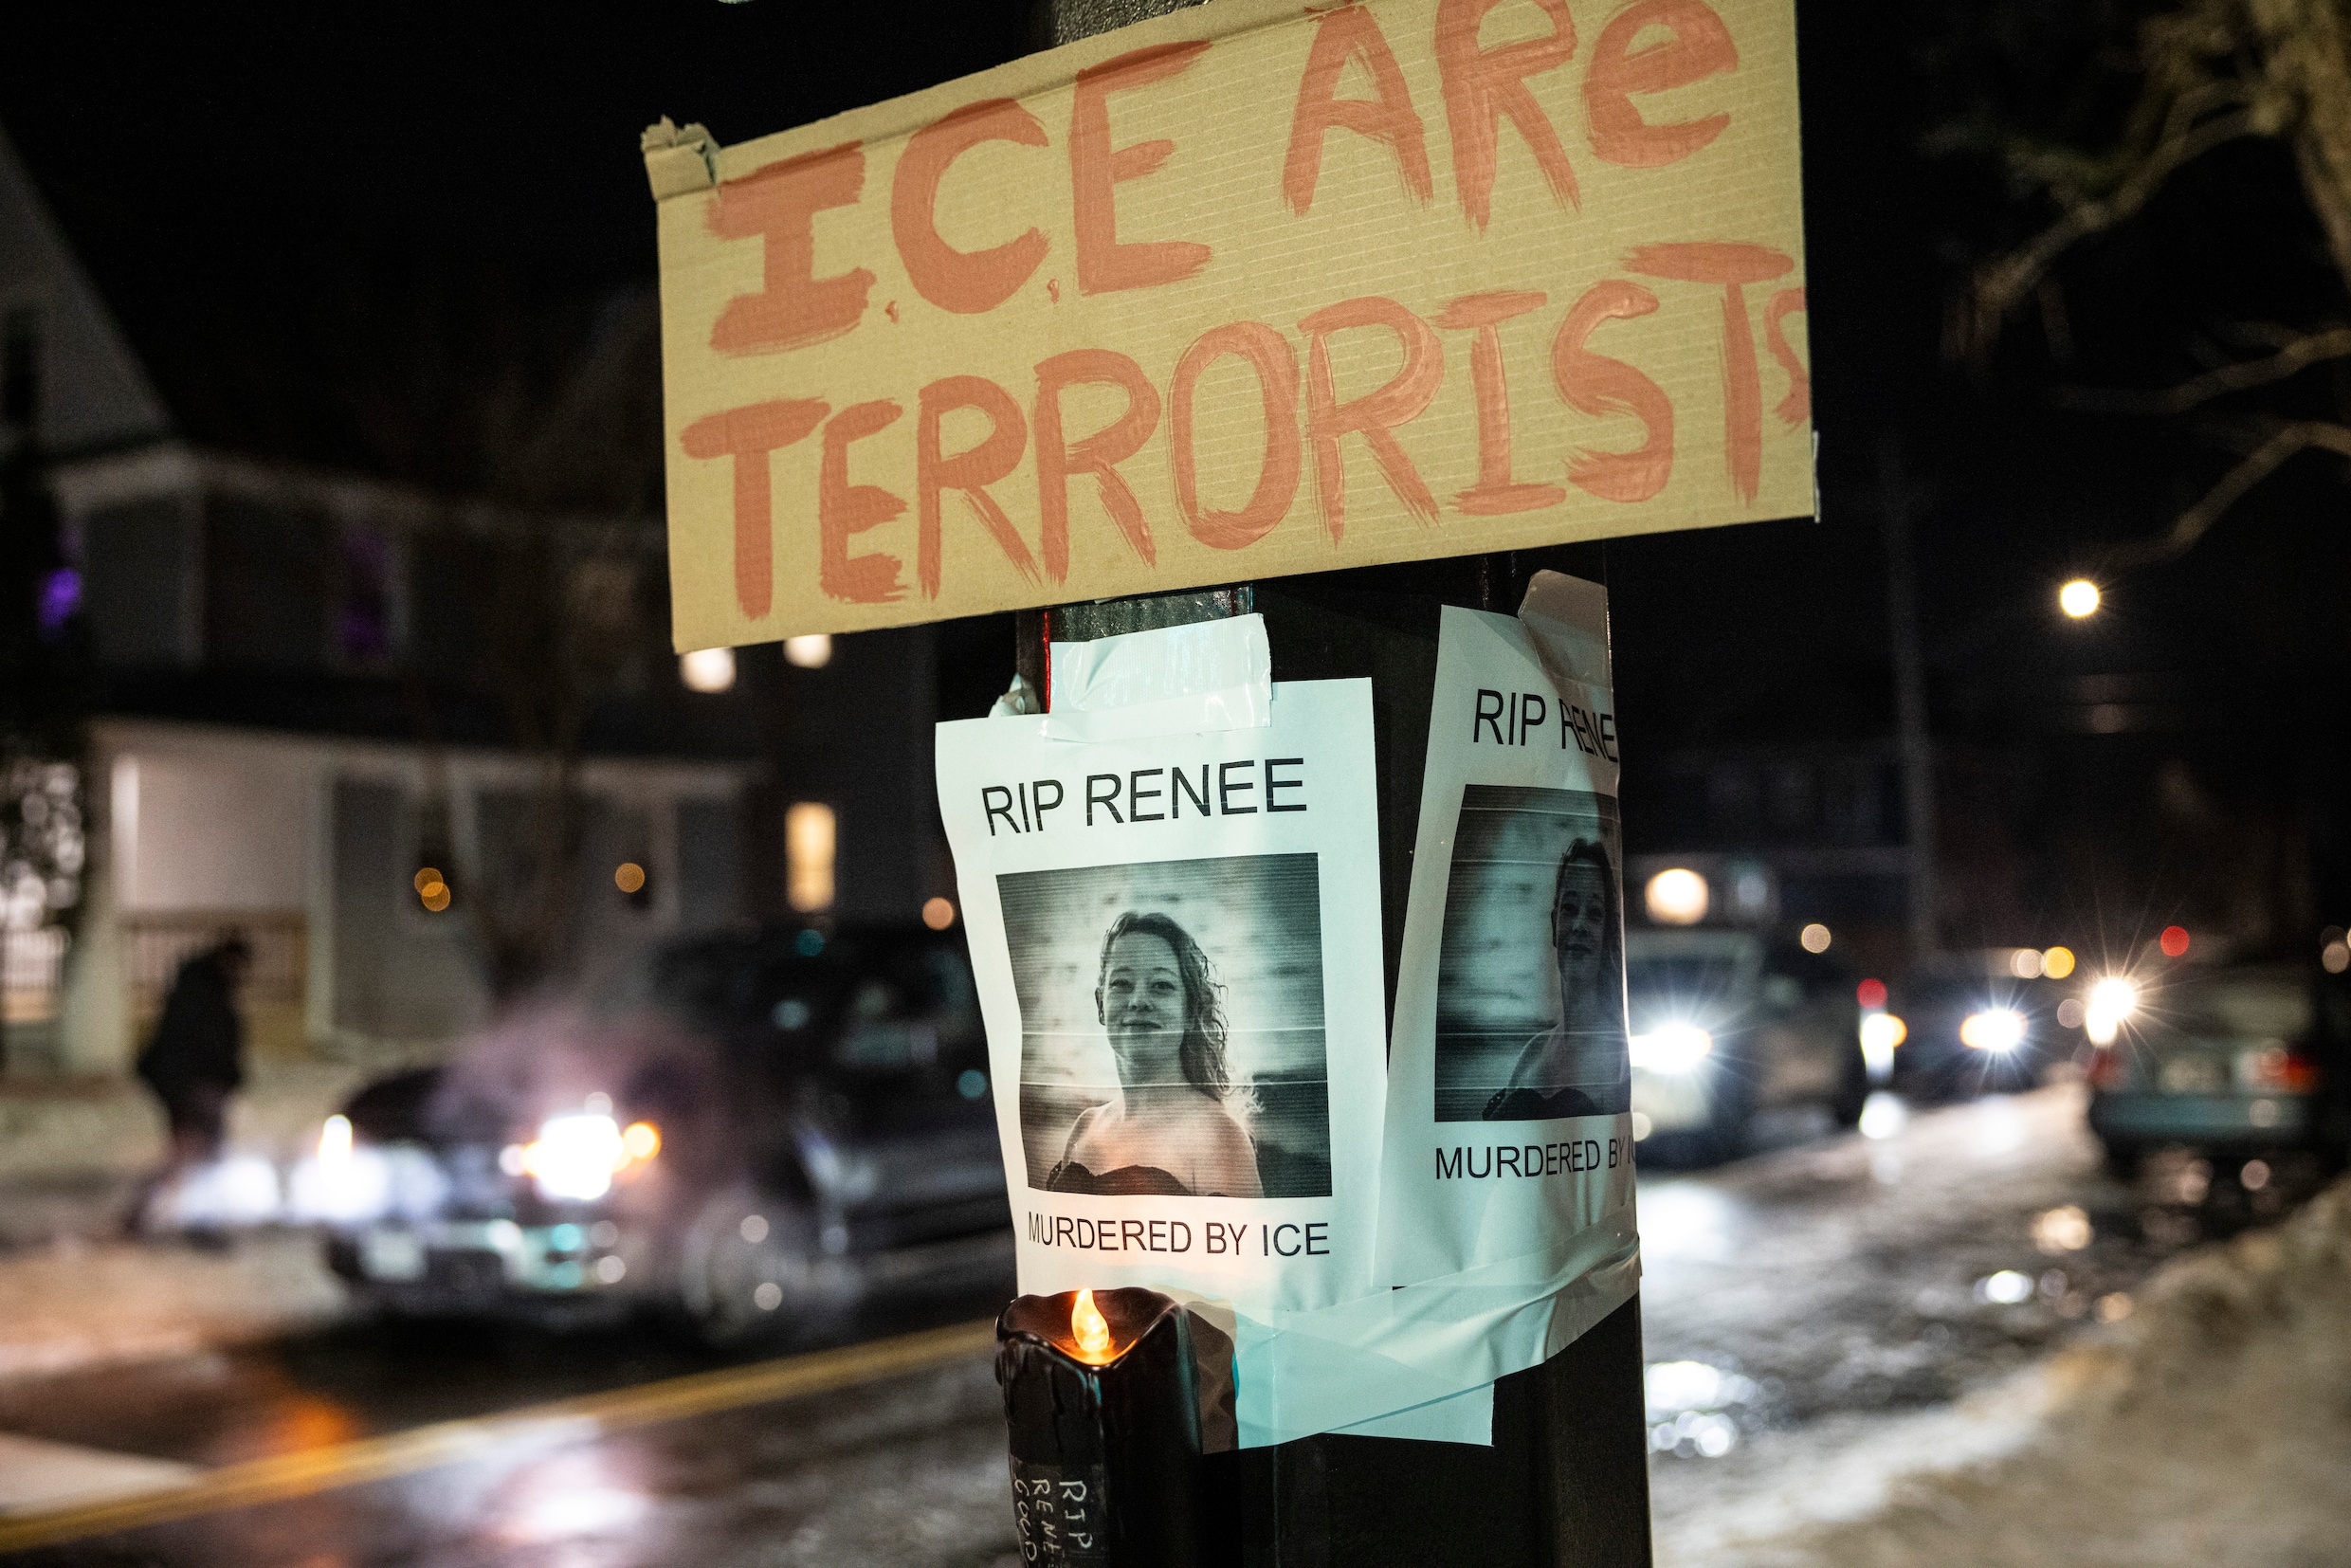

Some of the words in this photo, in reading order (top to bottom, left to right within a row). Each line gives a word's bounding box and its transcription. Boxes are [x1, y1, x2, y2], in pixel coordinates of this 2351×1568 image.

[1281, 0, 1739, 238] ARe
[680, 242, 1812, 621] TERRORISTS
[1471, 688, 1546, 746] RIP
[1558, 698, 1619, 763] RENE
[981, 778, 1064, 836] RIP
[1085, 757, 1307, 826] RENEE
[1435, 1140, 1600, 1179] MURDERED
[1609, 1137, 1626, 1169] BY
[1028, 1211, 1192, 1253] MURDERED
[1206, 1221, 1248, 1256] BY
[1263, 1222, 1330, 1256] ICE
[1058, 1480, 1093, 1549] RIP
